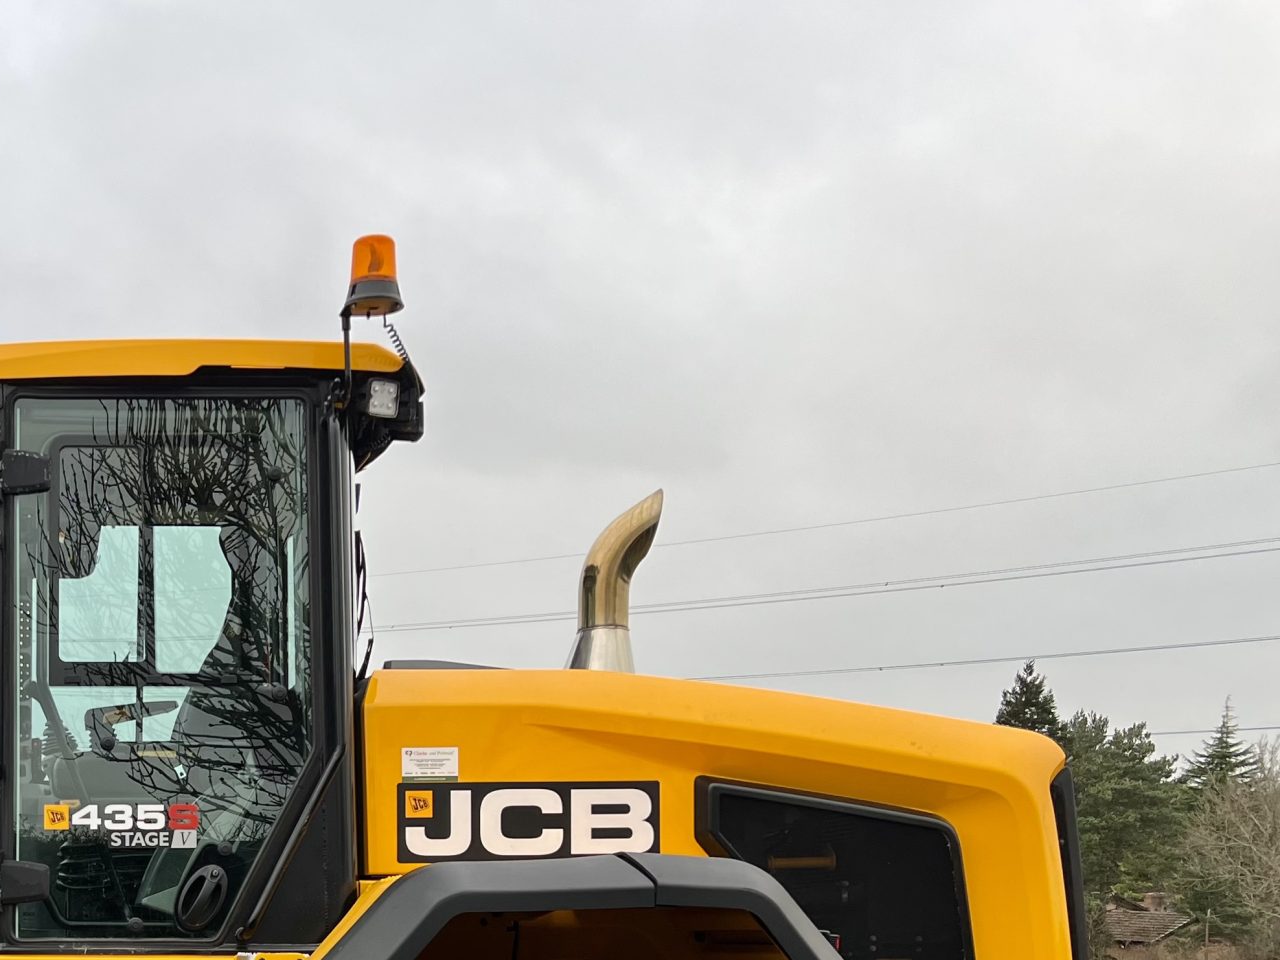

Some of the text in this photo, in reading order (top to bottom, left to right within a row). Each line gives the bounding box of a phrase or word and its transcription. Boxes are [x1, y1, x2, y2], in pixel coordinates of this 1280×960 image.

[71, 803, 199, 830] 435S
[405, 788, 655, 856] JCB
[110, 832, 169, 847] STAGE
